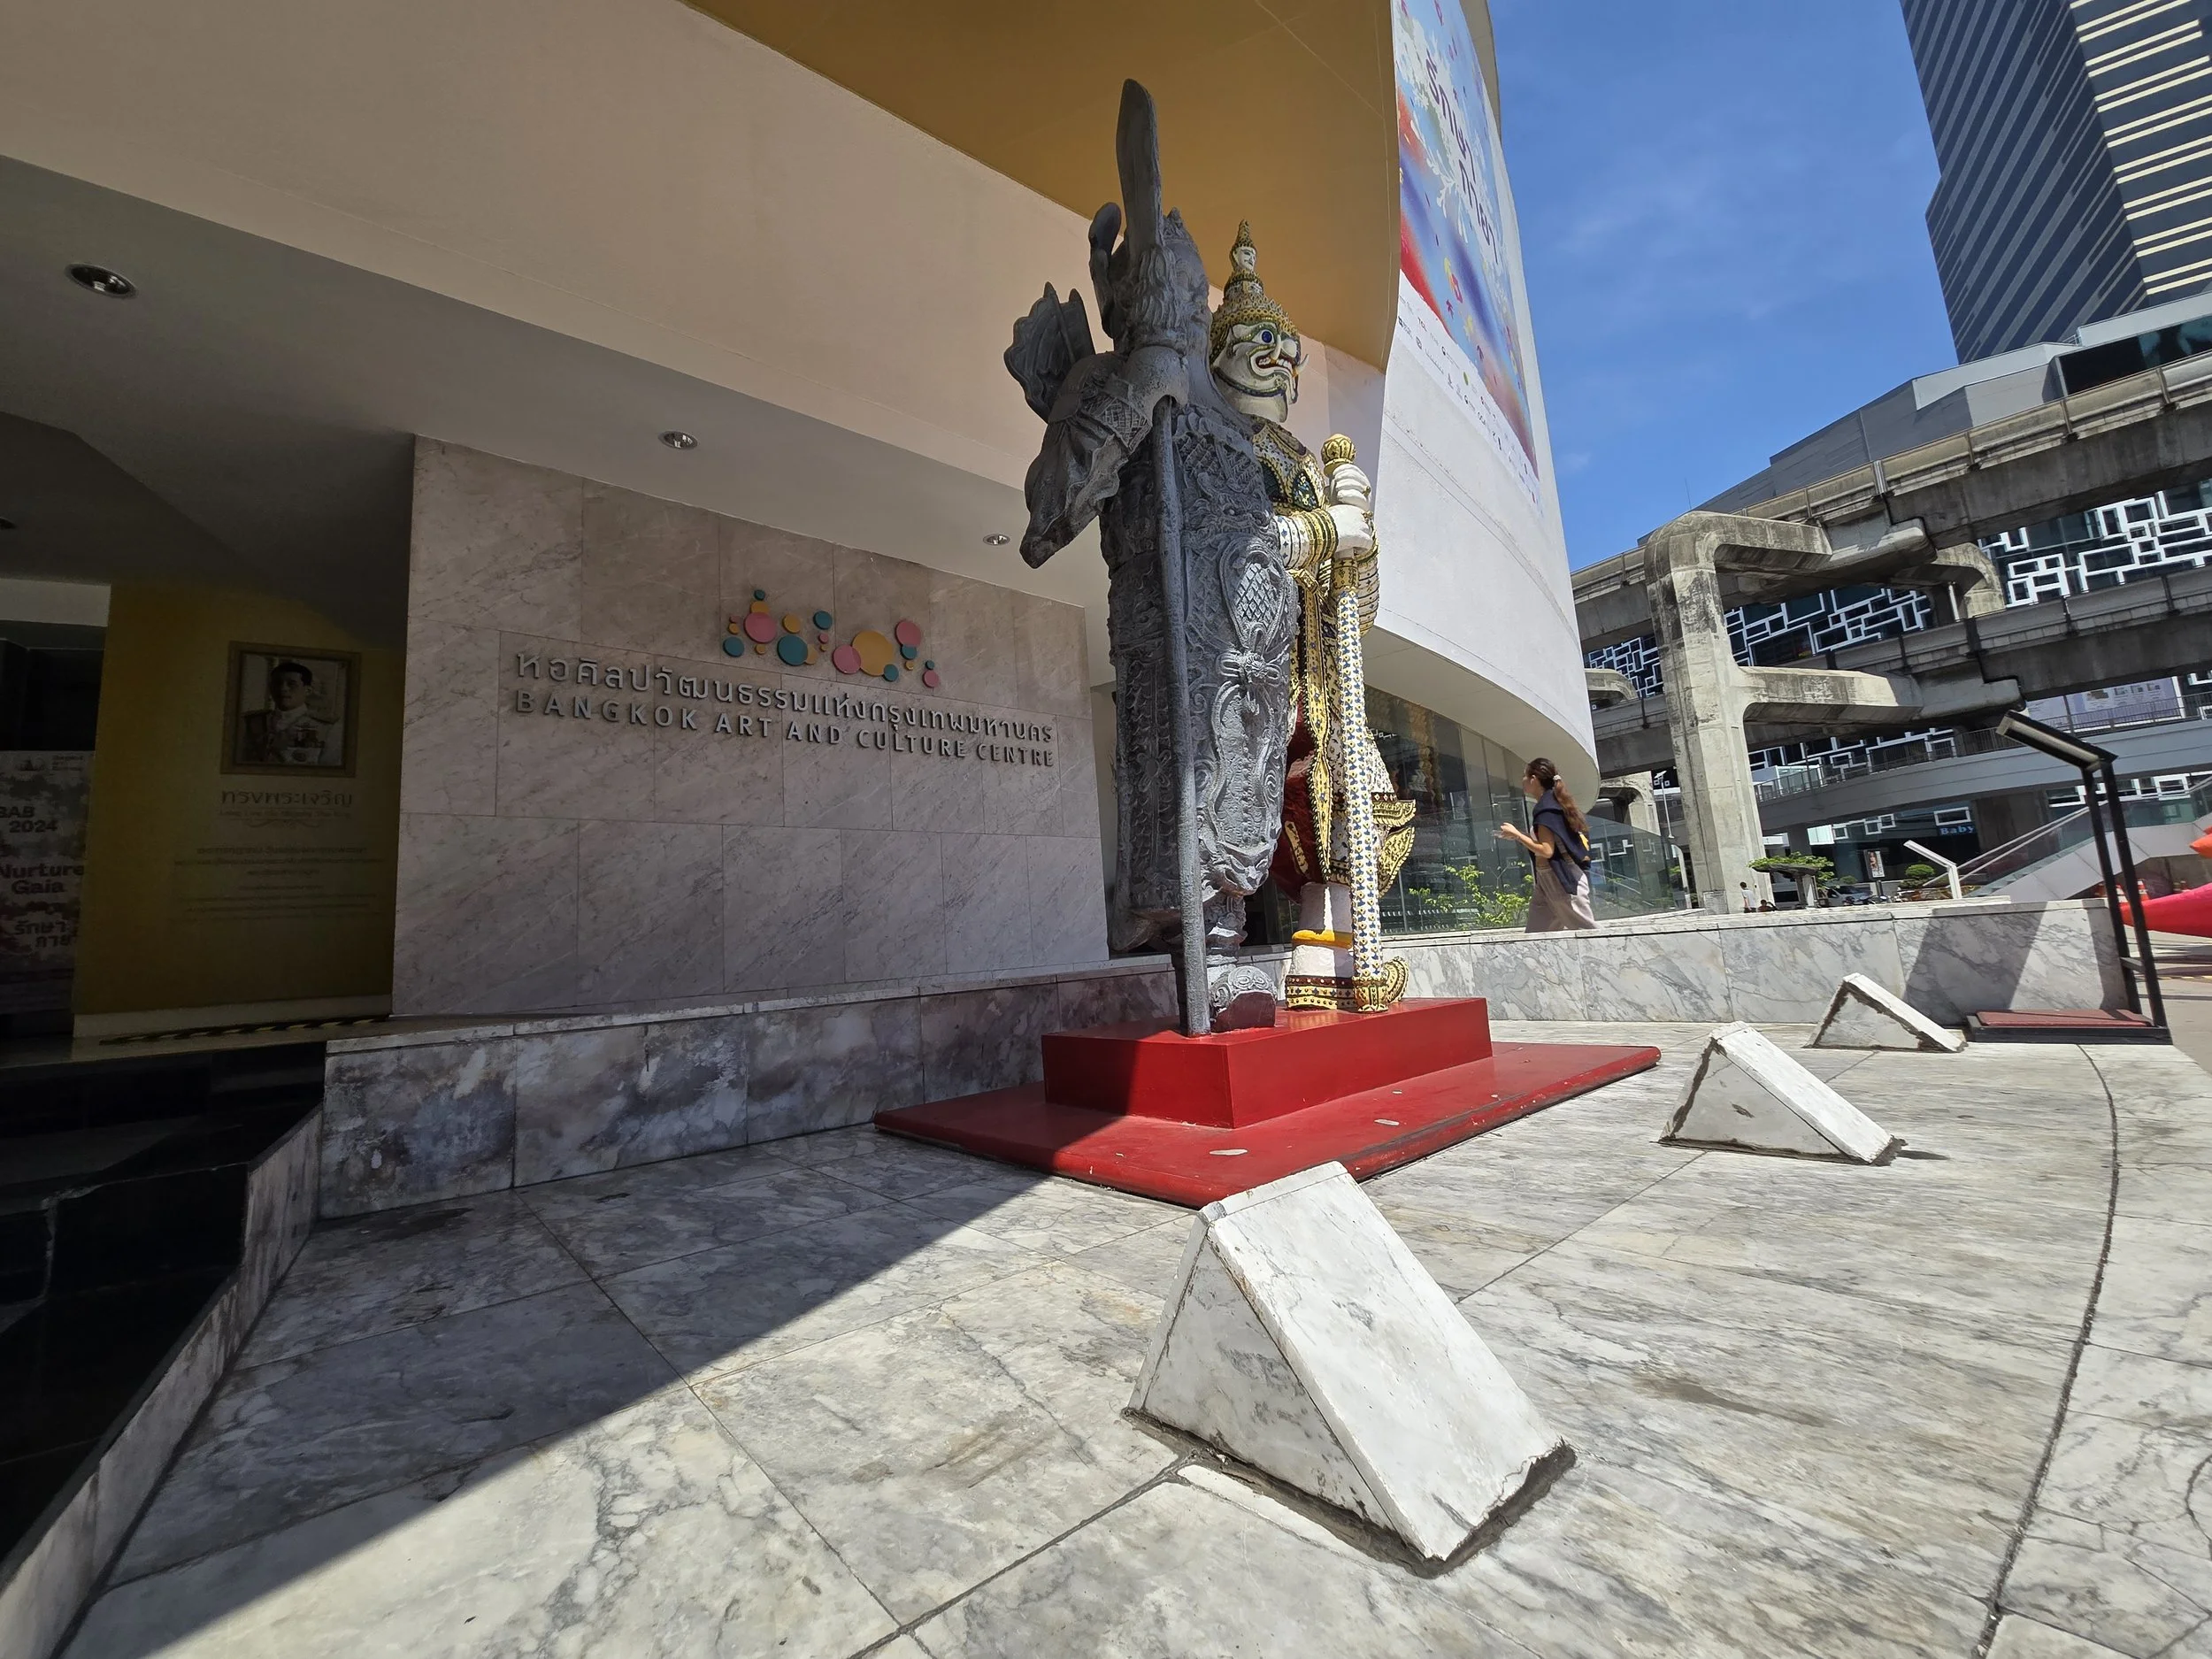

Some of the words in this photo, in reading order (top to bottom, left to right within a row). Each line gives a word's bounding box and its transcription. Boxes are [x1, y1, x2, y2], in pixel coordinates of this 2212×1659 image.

[517, 653, 1054, 743] หอศิลปวัฒนธรรมแห่งกรุงเทพมหานคร
[516, 688, 697, 730] BANGKOK
[715, 712, 772, 737] ART
[787, 720, 840, 743] AND
[858, 729, 966, 757] CULTURE
[977, 742, 1054, 767] CENTRE
[221, 790, 353, 807] ทรงพระเจริญ
[9, 818, 58, 833] 2024
[12, 879, 65, 895] Gaia
